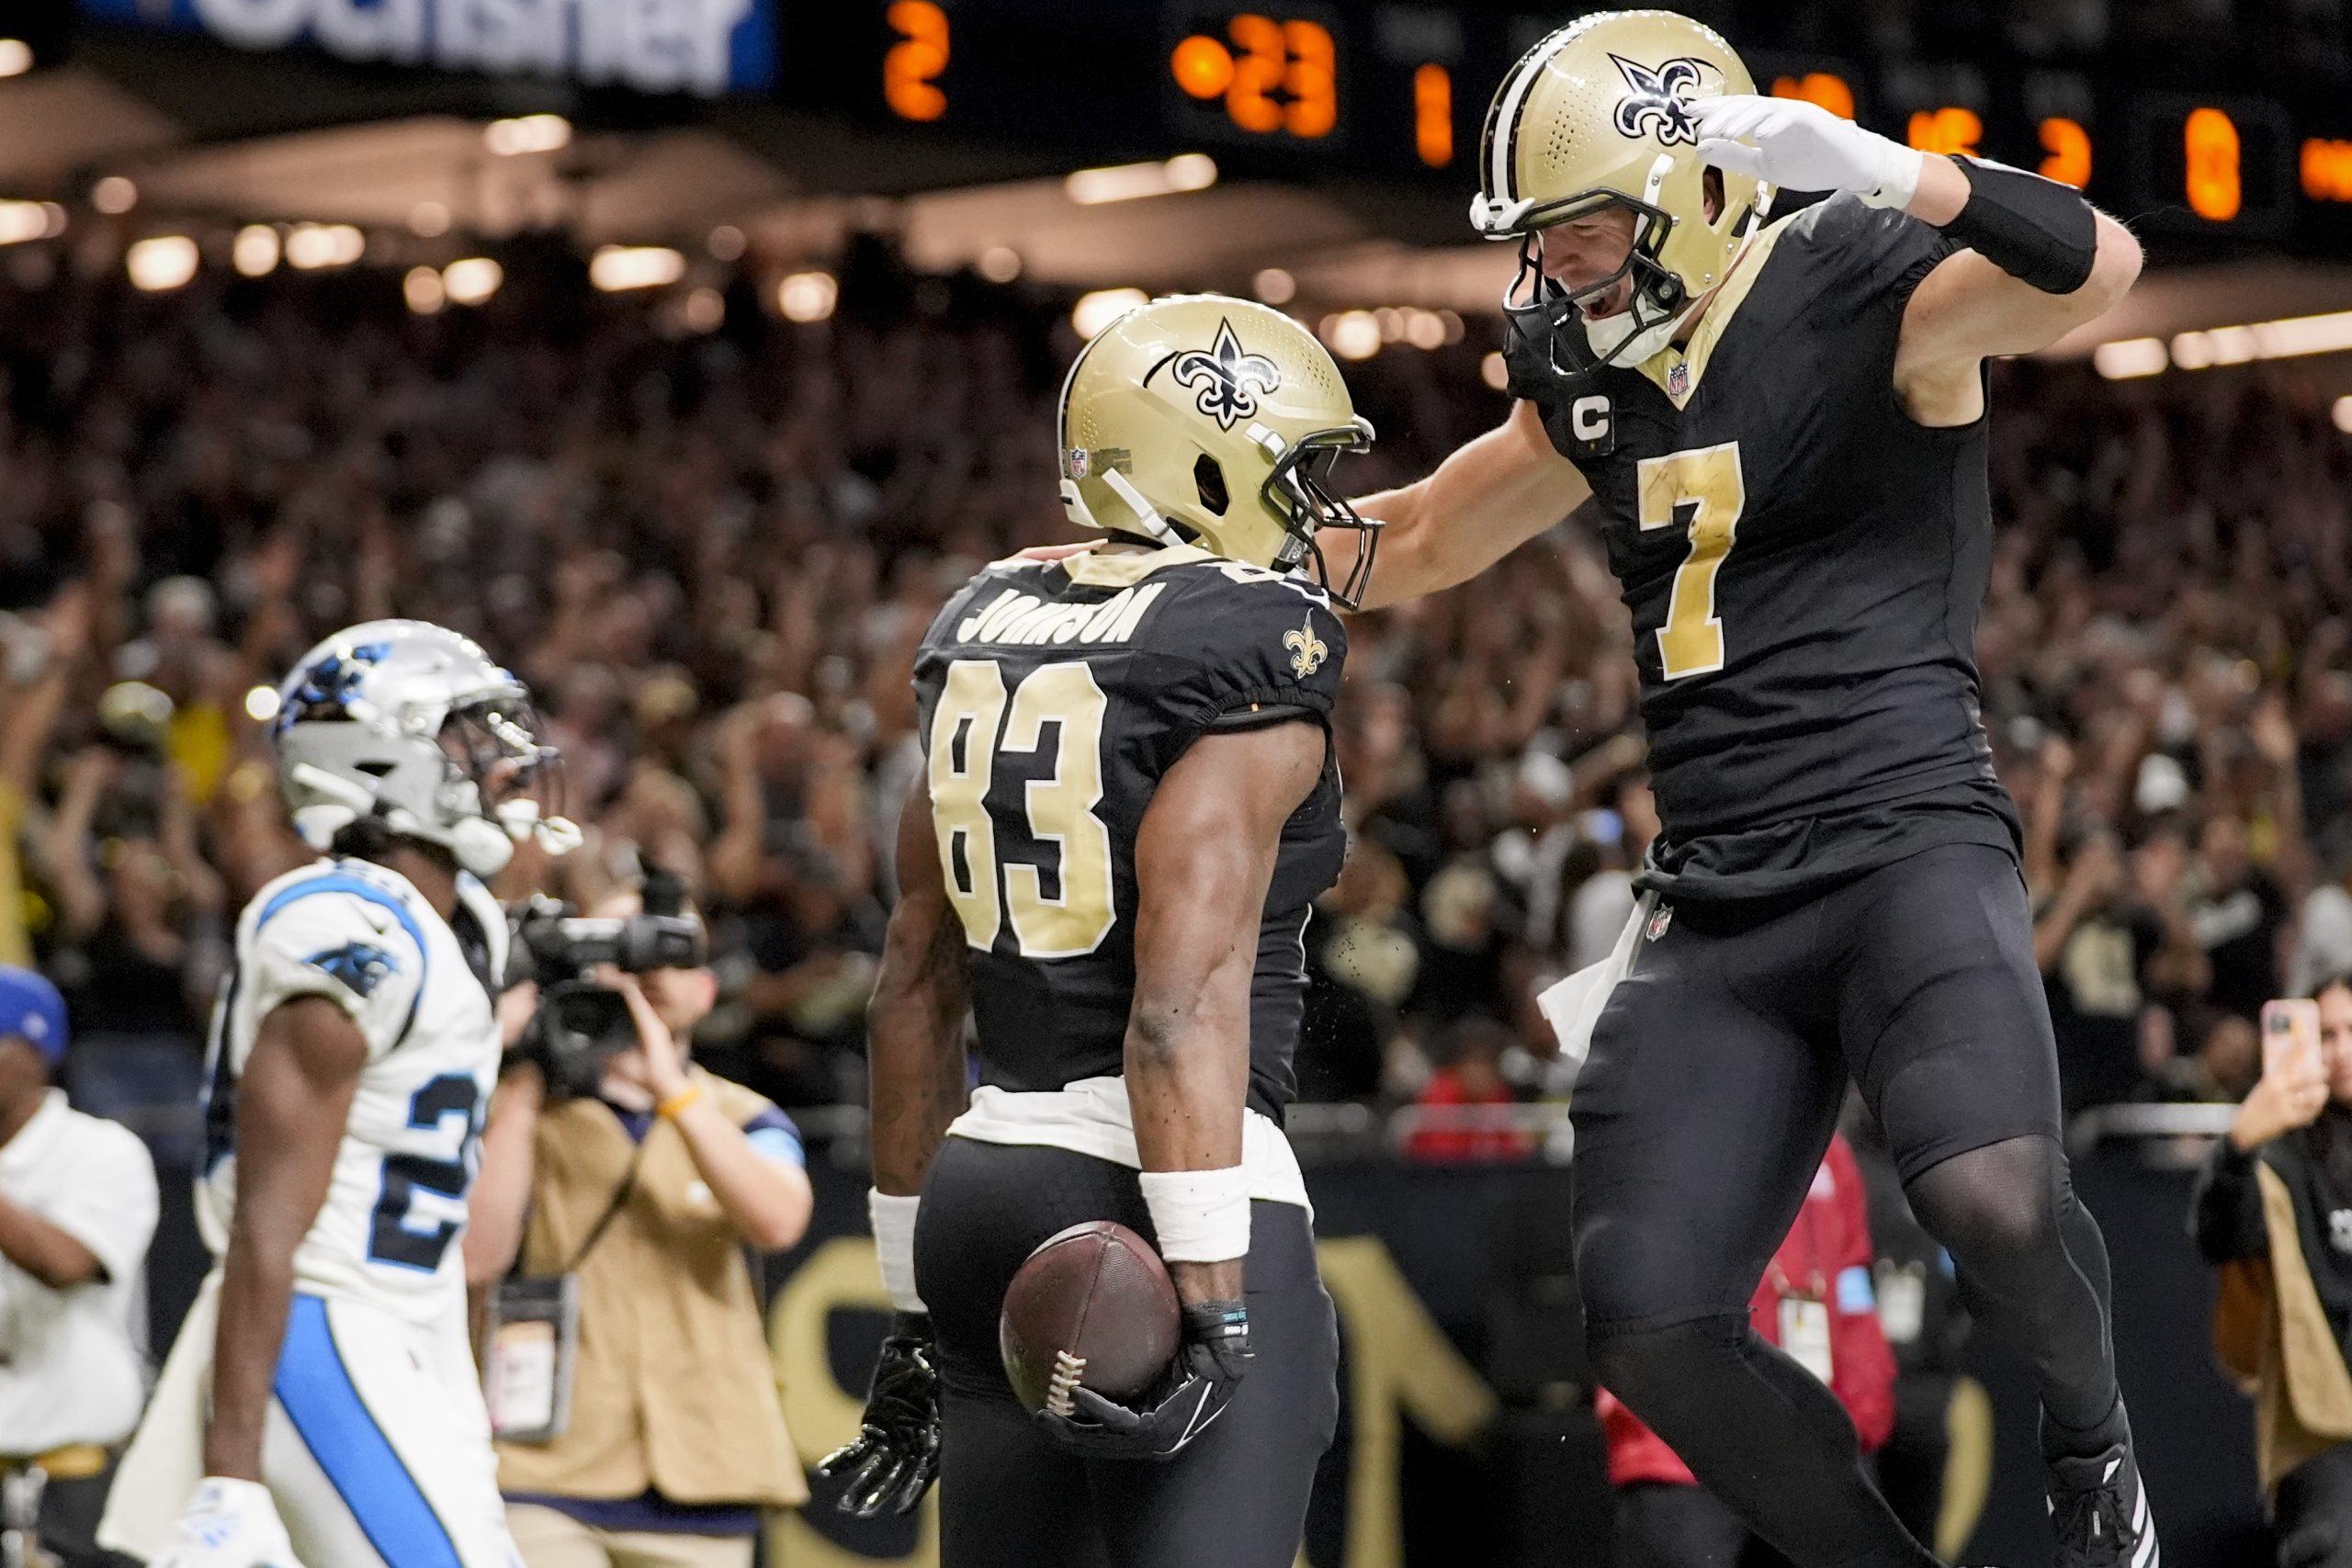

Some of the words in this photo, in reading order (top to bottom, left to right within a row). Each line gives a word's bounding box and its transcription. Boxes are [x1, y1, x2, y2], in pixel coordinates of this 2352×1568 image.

[1572, 395, 1610, 441] C
[956, 581, 1167, 645] JOHNSON
[1637, 440, 1746, 682] 7
[928, 660, 1117, 957] 83
[366, 1069, 480, 1275] 2
